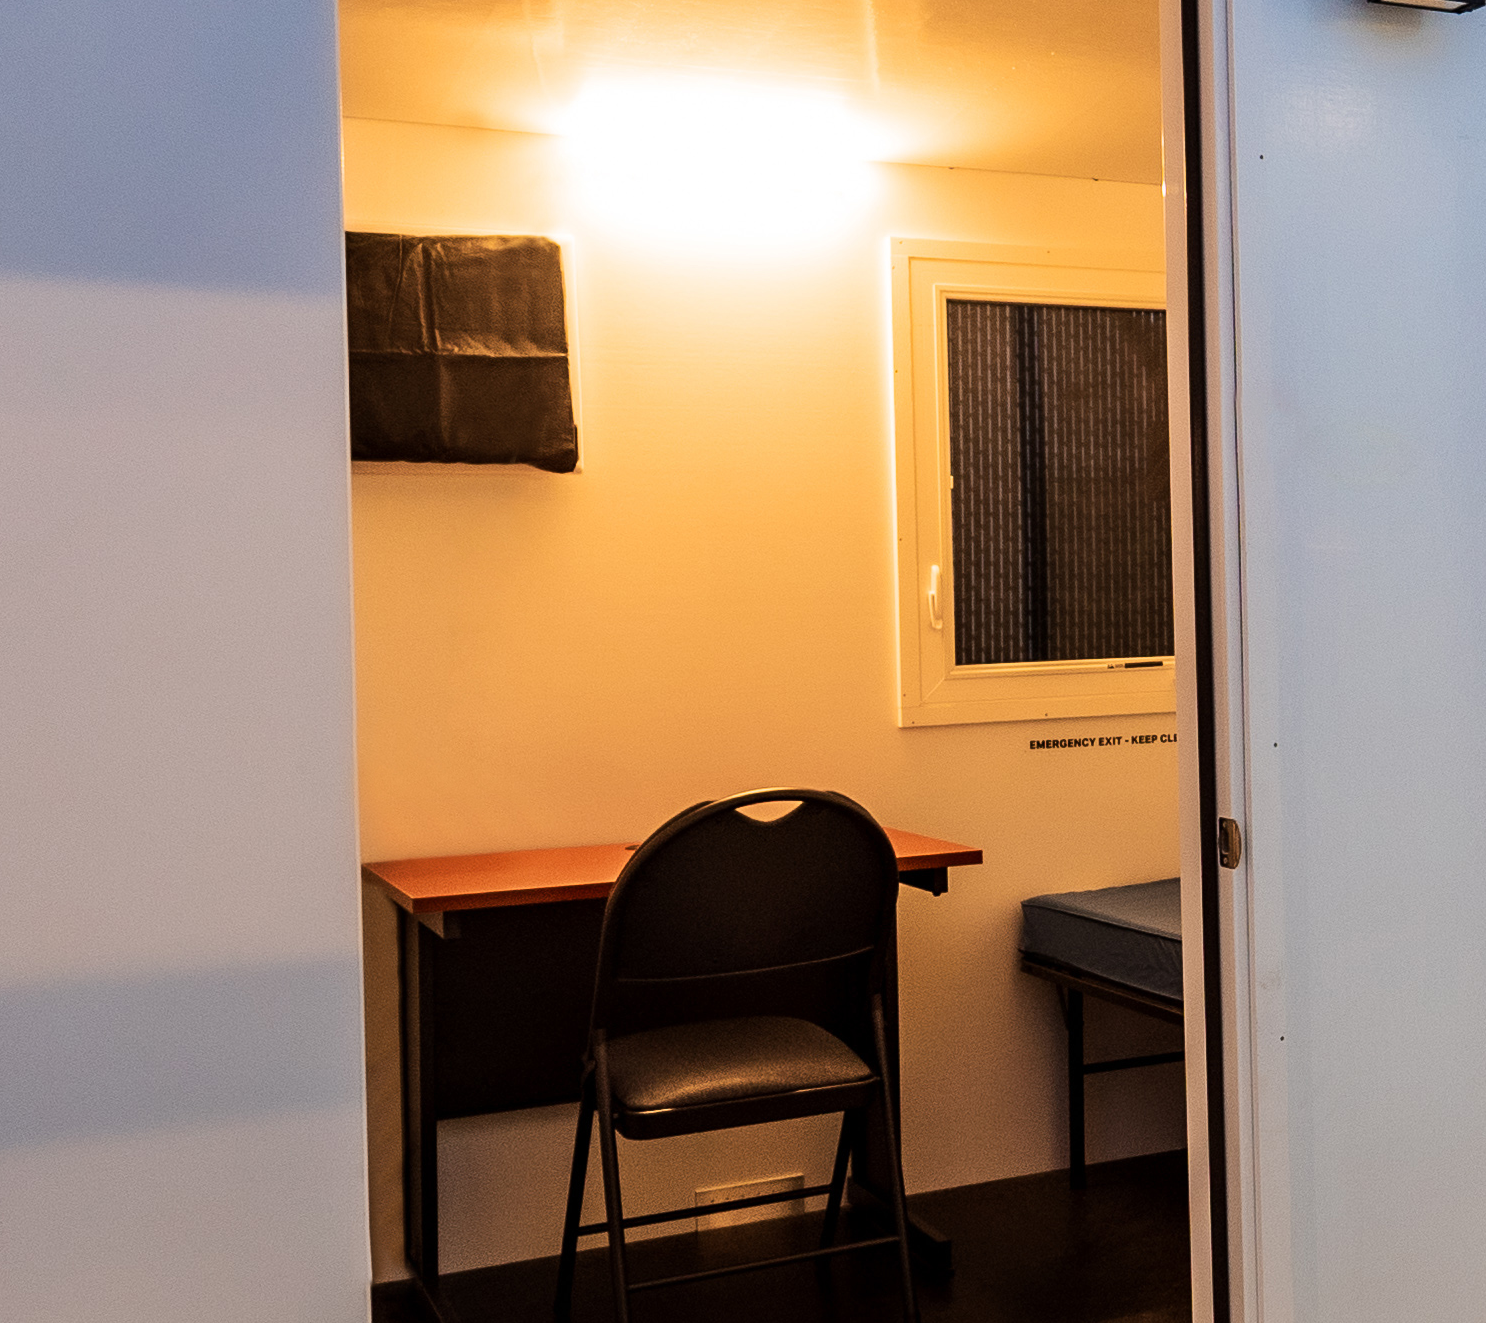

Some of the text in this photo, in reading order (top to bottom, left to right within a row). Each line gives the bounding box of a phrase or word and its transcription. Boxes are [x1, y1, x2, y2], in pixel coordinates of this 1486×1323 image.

[1029, 737, 1096, 750] EMERGENCY
[1098, 736, 1122, 747] EXIT
[1131, 734, 1158, 745] KEEP
